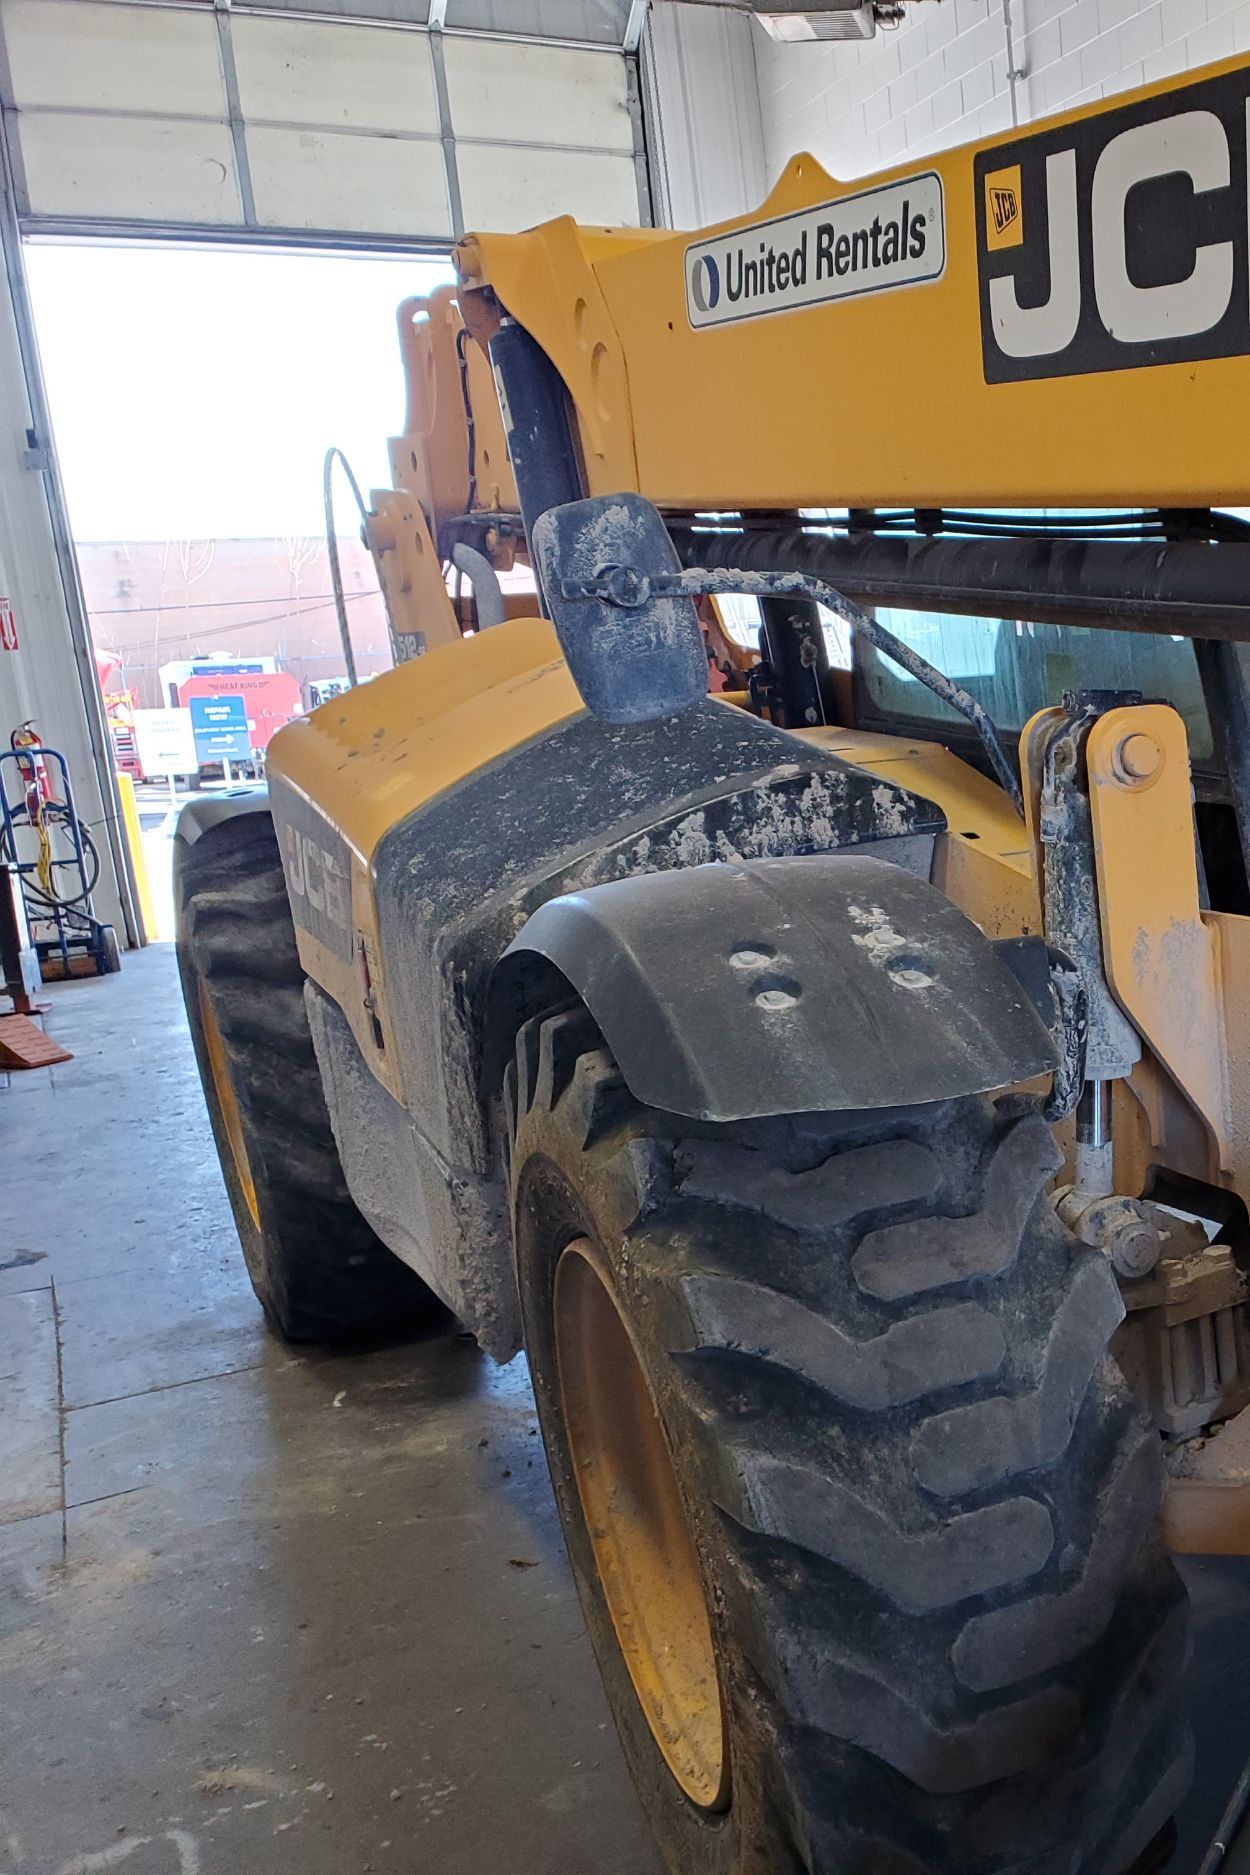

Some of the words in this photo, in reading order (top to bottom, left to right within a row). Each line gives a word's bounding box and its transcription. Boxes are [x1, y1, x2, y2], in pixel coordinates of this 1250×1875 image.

[994, 191, 1016, 229] JCB
[726, 229, 808, 302] United
[816, 199, 927, 280] Rentals
